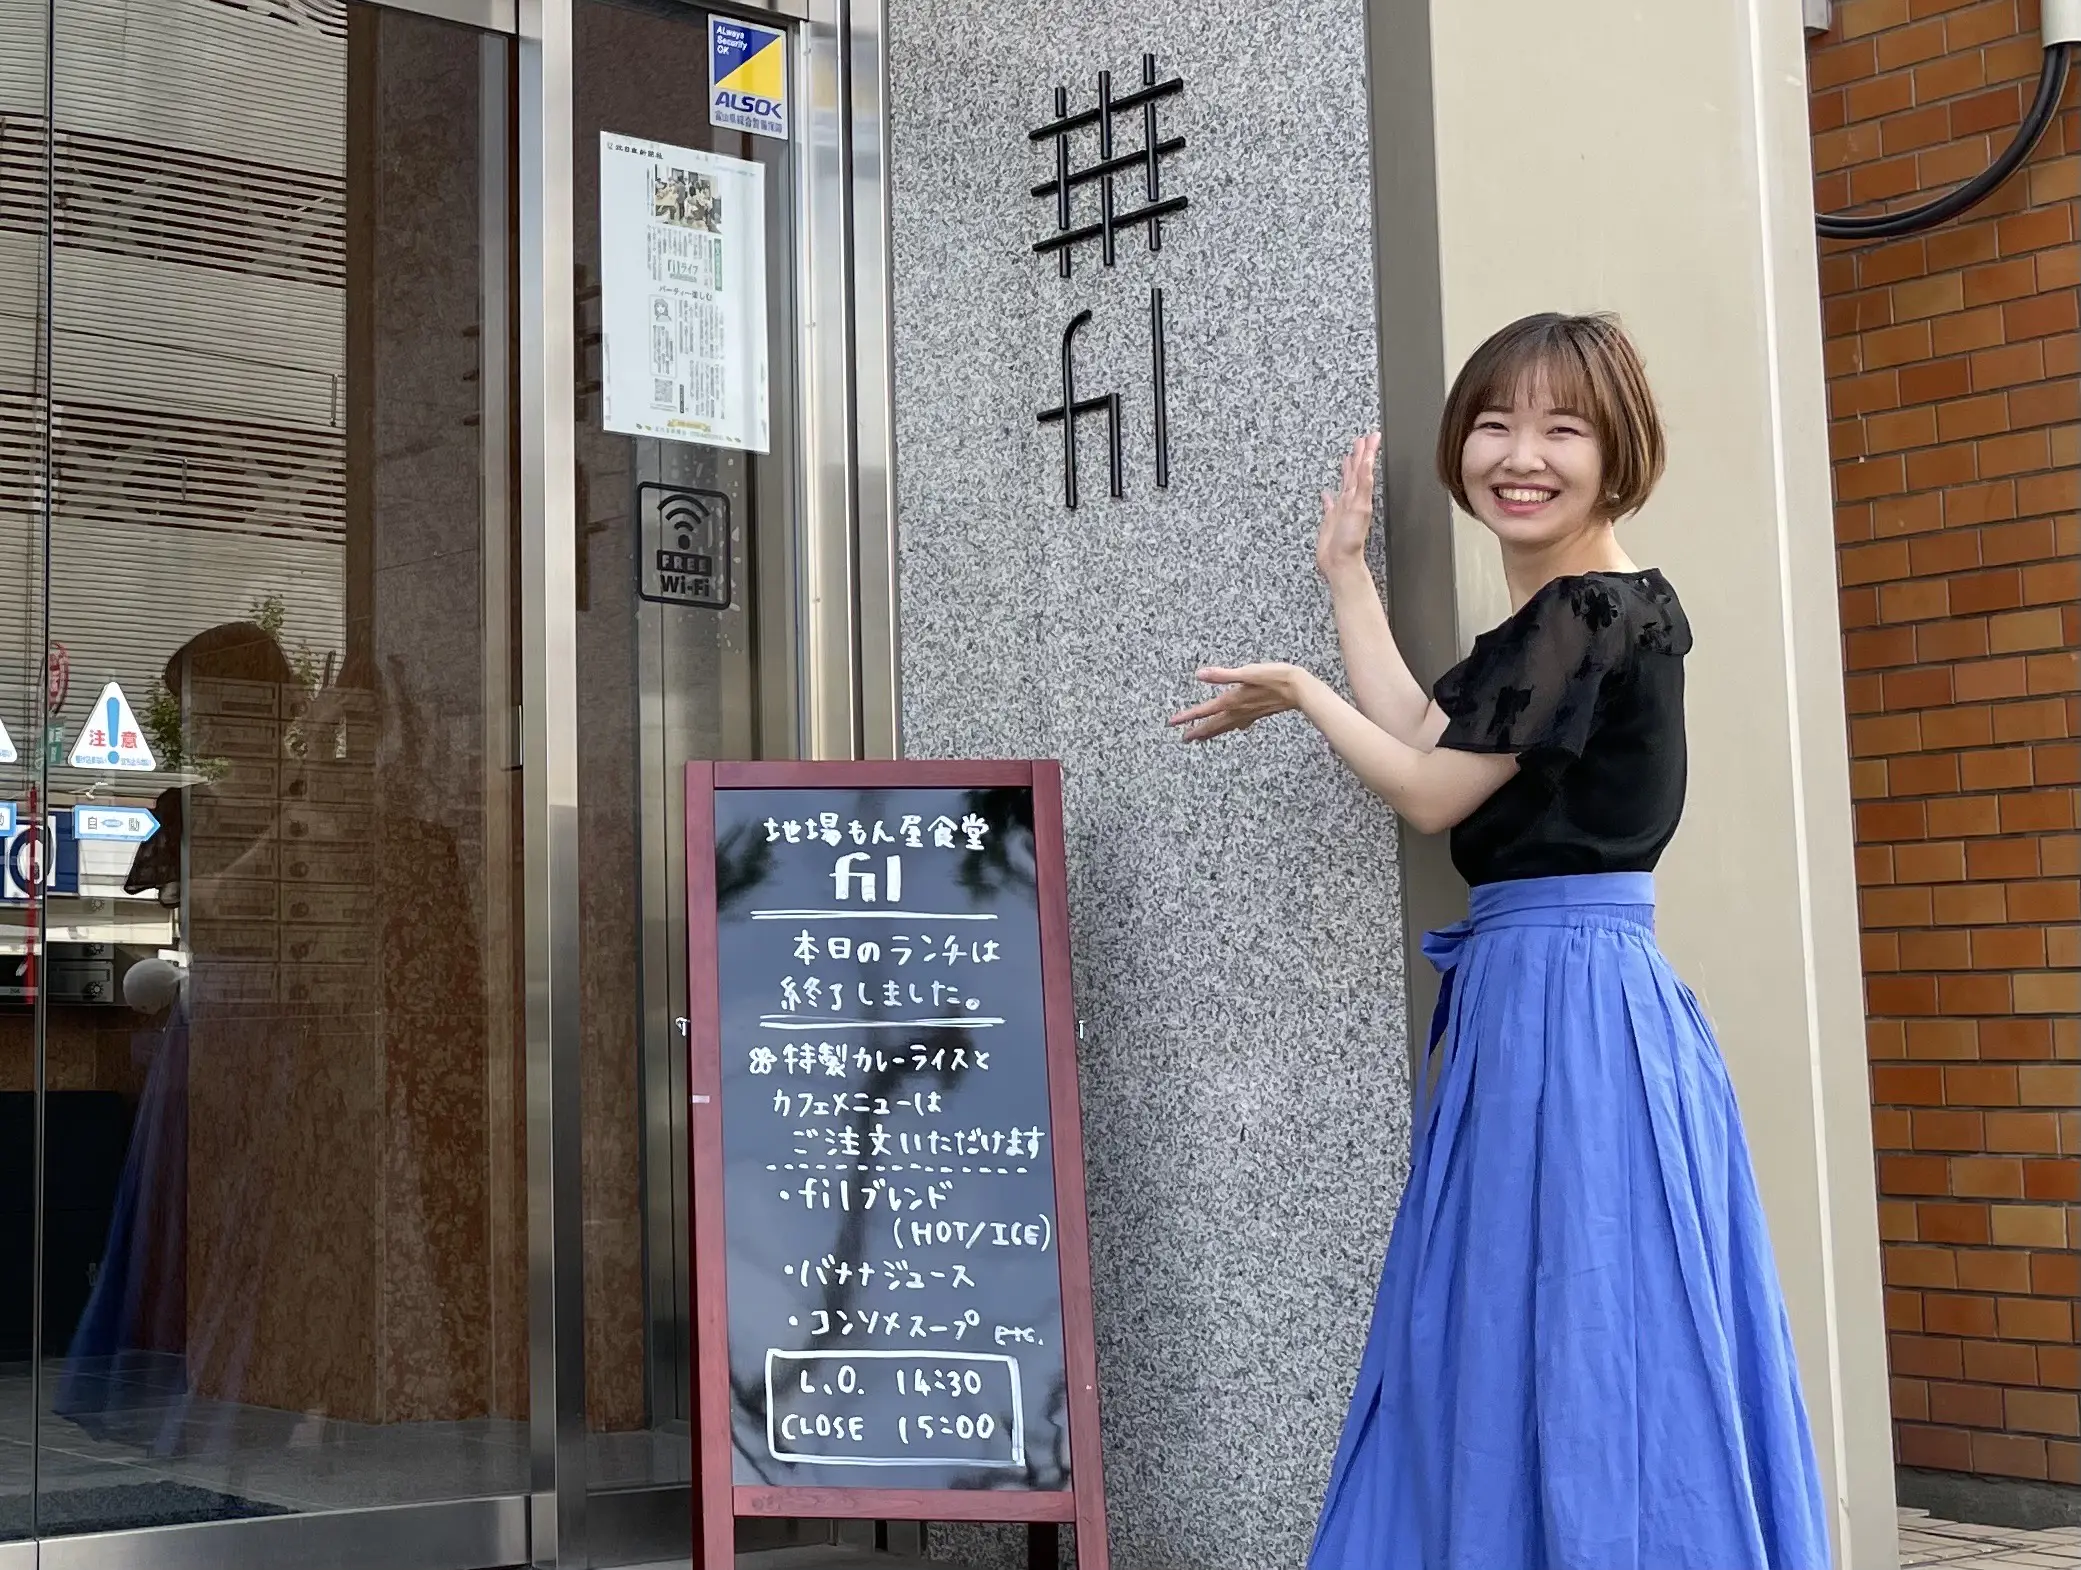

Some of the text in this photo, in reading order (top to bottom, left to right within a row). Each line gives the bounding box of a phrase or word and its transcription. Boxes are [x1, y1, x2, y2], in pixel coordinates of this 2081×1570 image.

[716, 35, 748, 51] Security
[717, 45, 730, 56] OK
[715, 91, 783, 120] ALSOK
[661, 554, 708, 572] FREE
[660, 575, 710, 597] Wi-Fi
[89, 729, 137, 748] 注意
[763, 812, 990, 850] 地場もん屋食堂
[829, 851, 901, 902] fil
[793, 929, 1000, 966] 本日のランチは
[780, 975, 980, 1012] 終了しました。
[783, 1041, 990, 1078] 特製カレーライスと
[772, 1088, 942, 1117] カフェメニューは
[793, 1123, 1046, 1160] ご注文いただけます
[896, 1368, 982, 1396] 14:30
[781, 1413, 995, 1445] CLOSE 15:00
